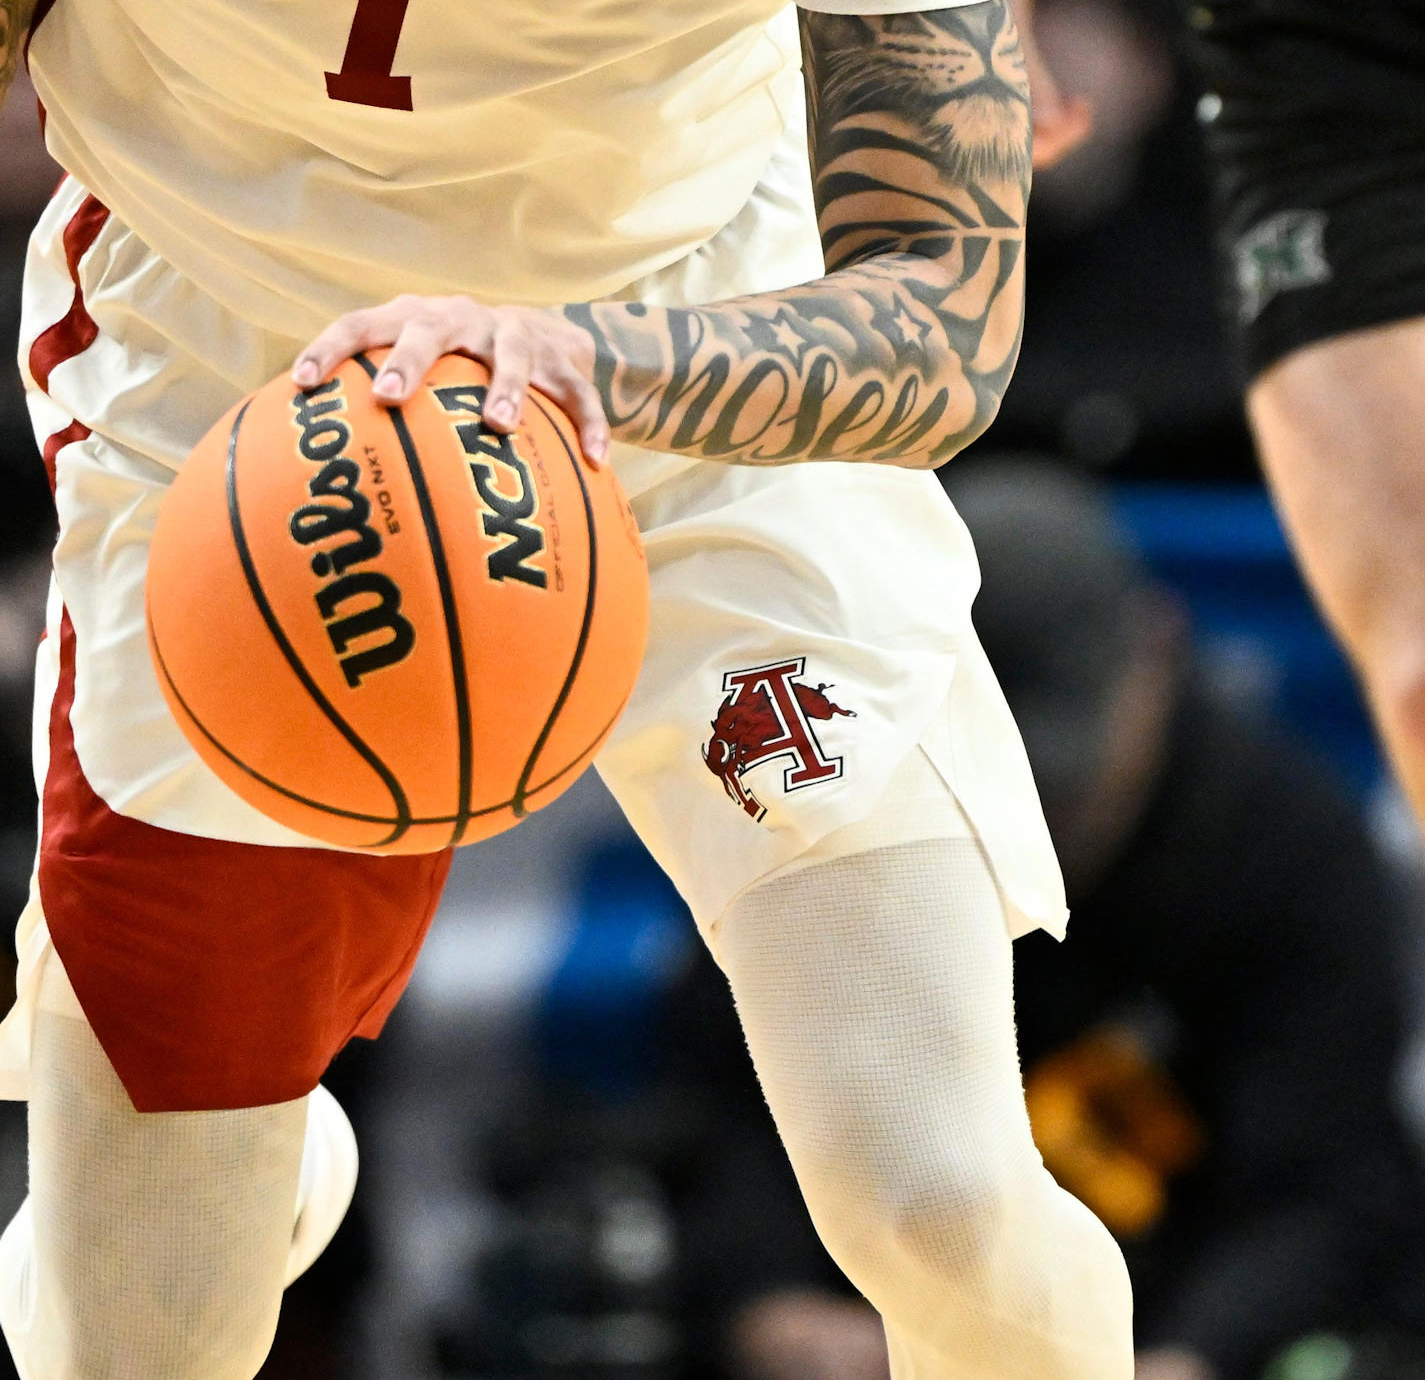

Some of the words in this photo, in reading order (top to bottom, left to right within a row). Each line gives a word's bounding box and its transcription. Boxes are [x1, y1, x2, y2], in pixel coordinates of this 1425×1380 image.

[363, 444, 387, 486] NXT
[373, 488, 401, 536] EVO
[433, 383, 549, 590] NCAA
[289, 376, 417, 690] Wilson
